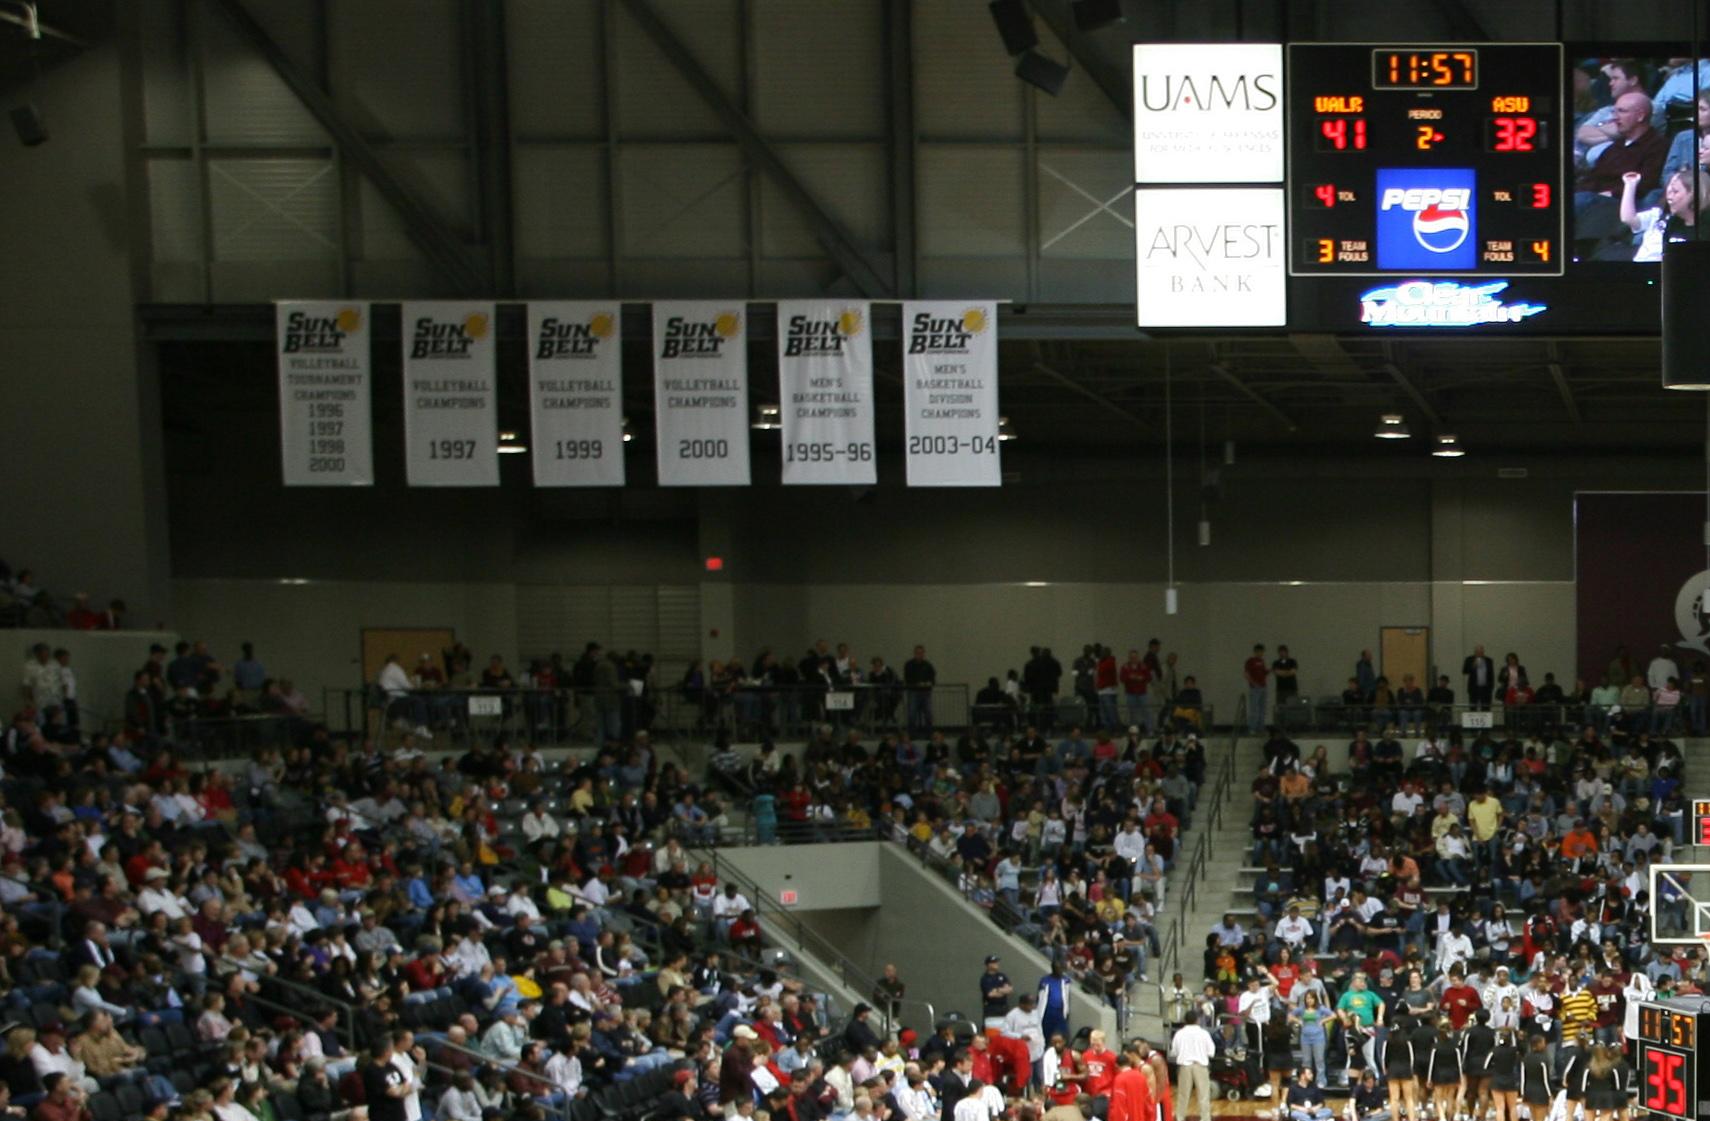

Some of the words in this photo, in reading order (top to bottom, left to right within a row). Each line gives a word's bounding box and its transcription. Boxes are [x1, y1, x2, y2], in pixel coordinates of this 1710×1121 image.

[1389, 54, 1473, 85] 11:57
[1142, 74, 1277, 111] UAMS
[1314, 97, 1363, 113] UALR
[1408, 110, 1442, 119] PERIOD
[1492, 97, 1530, 113] ASU
[1321, 118, 1367, 150] 41
[1417, 126, 1434, 149] 2
[1494, 118, 1537, 151] 32
[1315, 184, 1335, 208] 4
[1338, 192, 1356, 201] TOL
[1381, 188, 1471, 211] PEPSI
[1494, 192, 1511, 201] TOL
[1532, 183, 1551, 208] 3
[1146, 224, 1278, 270] ARVEST
[1319, 239, 1334, 263] 3
[1341, 241, 1367, 251] TEAM
[1487, 241, 1512, 251] TEAM
[1533, 241, 1549, 262] 4
[1338, 252, 1368, 262] FOULS
[1484, 252, 1514, 262] FOULS
[1171, 274, 1252, 293] BANK
[287, 311, 339, 334] SUN
[414, 317, 466, 339] SUN
[540, 317, 591, 339] SUN
[665, 315, 717, 337] SUN
[788, 315, 840, 336] SUN
[912, 312, 964, 334] SUN
[284, 332, 346, 354] BELT
[410, 338, 474, 360] BELT
[536, 338, 599, 360] BELT
[661, 337, 725, 359] BELT
[784, 336, 848, 358] BELT
[908, 333, 972, 355] BELT
[290, 358, 359, 370] VOLLEYBALL
[934, 364, 967, 375] MEN'S
[287, 374, 363, 385] TOURNAMENT
[413, 379, 490, 392] VOLLEYBALL
[538, 379, 615, 392] VOLLEYBALL
[664, 379, 741, 391] VOLLEYBALL
[810, 378, 843, 389] MEN'S
[916, 379, 984, 390] BASKETBALL
[294, 390, 356, 401] CHAMPIONS
[416, 397, 486, 410] CHAMPIONS
[542, 397, 611, 410] CHAMPIONS
[668, 396, 737, 409] CHAMPIONS
[792, 392, 860, 404] BASKETBALL
[929, 393, 973, 405] DIVISION
[797, 407, 857, 418] CHAMPIONS
[921, 408, 981, 419] CHAMPIONS
[429, 440, 476, 460] 1997
[555, 440, 603, 460] 1999
[679, 439, 728, 459] 2000
[787, 442, 872, 462] 1995-96
[909, 436, 996, 456] 2003-04
[1644, 1008, 1694, 1048] 11:57
[1647, 1050, 1686, 1116] 35
